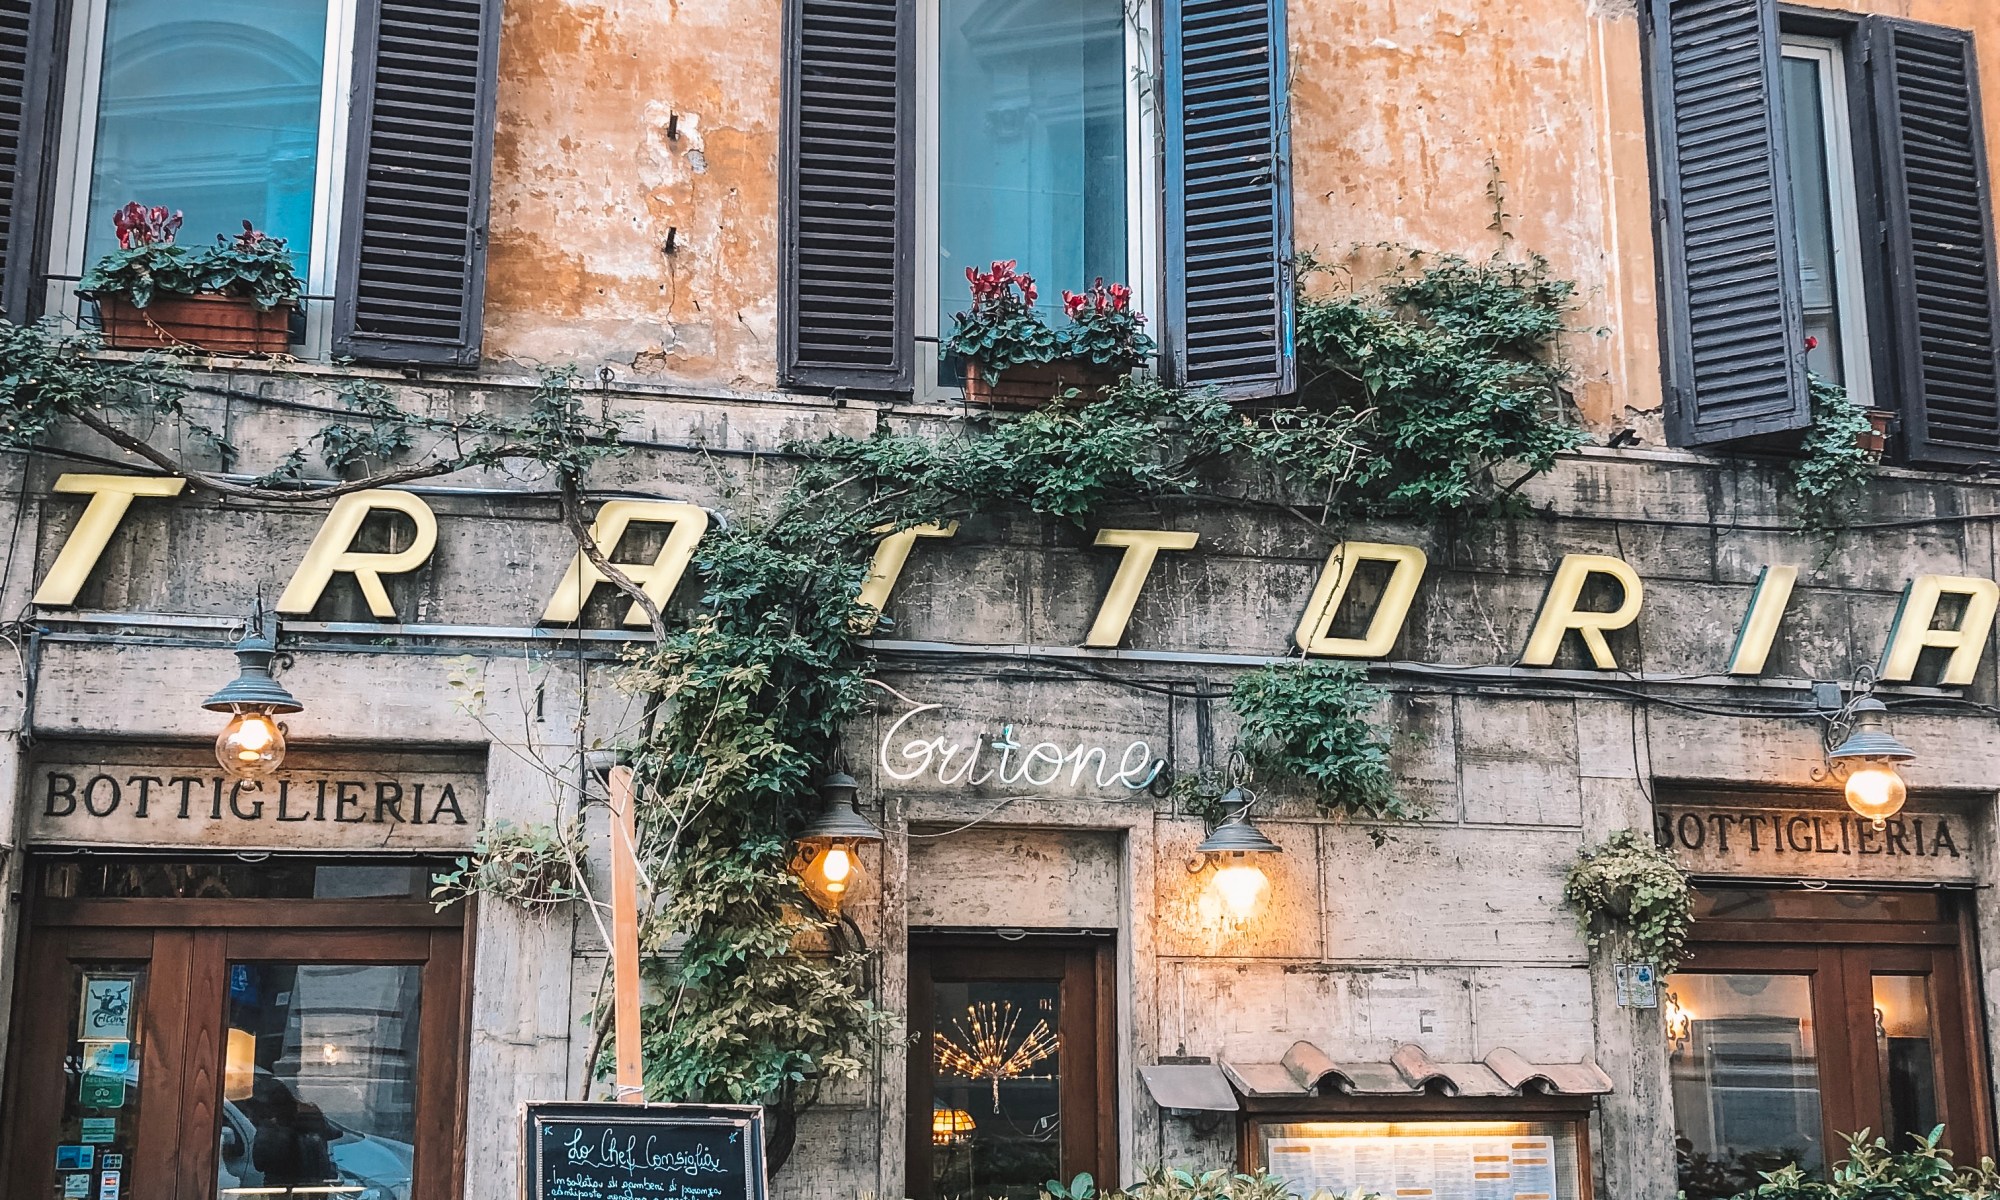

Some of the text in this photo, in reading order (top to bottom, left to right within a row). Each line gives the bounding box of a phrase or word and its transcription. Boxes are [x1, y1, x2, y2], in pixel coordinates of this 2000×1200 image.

[31, 473, 1999, 687] TRATTORIA
[43, 770, 468, 825] BOTTIGLIERIA
[1654, 811, 1961, 858] BOTTIGLIERIA
[601, 1128, 635, 1176] Chef
[646, 1135, 720, 1176] Consiglia
